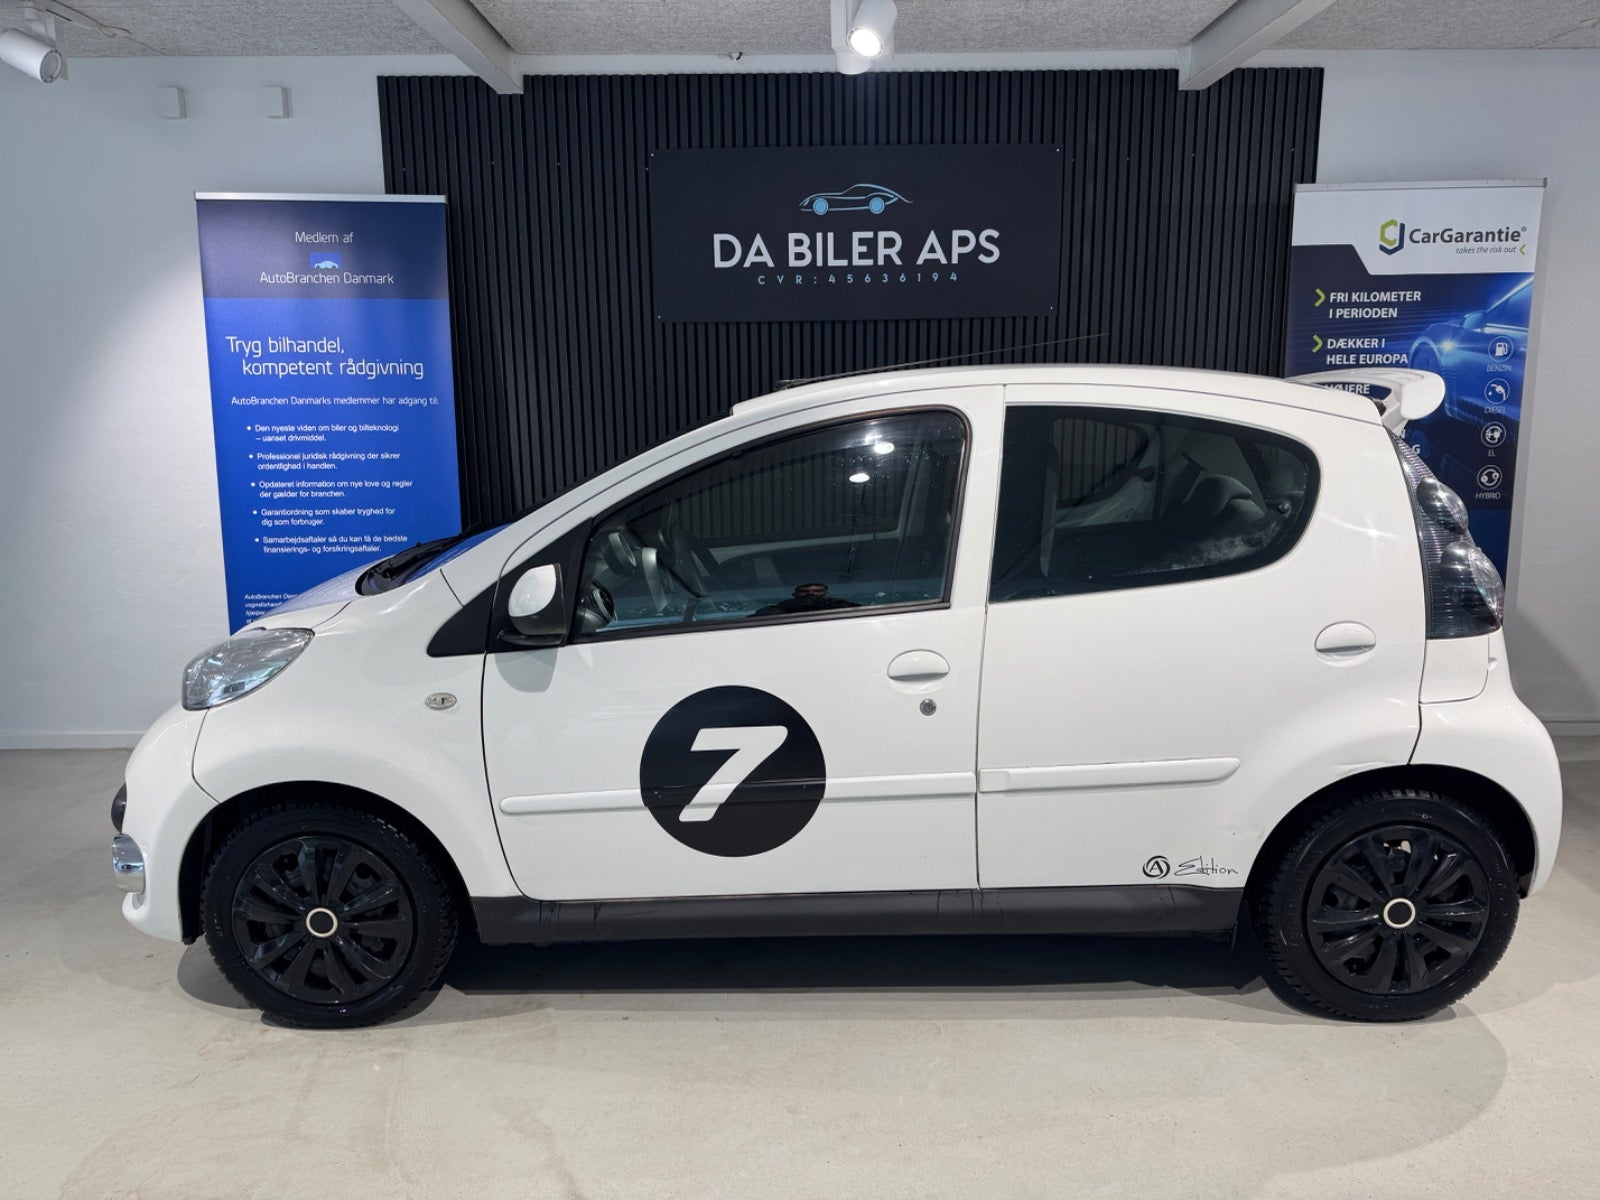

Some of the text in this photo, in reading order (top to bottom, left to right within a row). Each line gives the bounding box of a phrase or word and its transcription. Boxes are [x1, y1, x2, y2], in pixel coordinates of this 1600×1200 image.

[295, 232, 354, 243] Medlem af
[713, 229, 1000, 268] DA BILER APS
[1476, 246, 1489, 254] the
[260, 272, 394, 284] AutoBranchen Danmark
[1330, 291, 1421, 303] FRI KILOMETER
[1336, 308, 1398, 319] PERIODEN
[225, 336, 345, 358] Tryg bilhandel,
[1328, 338, 1379, 349] DÆKKER
[1327, 353, 1408, 365] HELE EUROPA
[242, 359, 424, 380] kompetent rådgivning
[1487, 364, 1511, 372] BENZIN
[232, 396, 288, 405] AutoBranchen
[291, 396, 331, 405] Danmarks
[334, 396, 380, 405] medlemmer
[383, 396, 395, 405] har
[399, 396, 427, 407] adgang
[255, 424, 270, 432] Den
[272, 425, 295, 433] nyeste
[297, 424, 316, 432] viden
[332, 424, 346, 432] biler
[348, 425, 357, 433] og
[359, 424, 399, 433] bilteknologi
[288, 434, 327, 442] drivmiddel.
[302, 452, 328, 461] juridisk
[329, 452, 366, 461] rådgivning
[1488, 449, 1496, 457] EL
[258, 462, 301, 471] ordentlighed
[307, 462, 338, 470] handlen.
[259, 480, 294, 490] Opdateret
[296, 480, 335, 488] information
[350, 481, 363, 489] nye
[381, 481, 390, 489] og
[392, 480, 412, 488] regler
[273, 491, 298, 500] gælder
[1476, 491, 1501, 500] HYBRID
[261, 508, 313, 517] Garantiordning
[357, 508, 384, 516] tryghed
[385, 507, 396, 515] for
[262, 519, 273, 527] dig
[263, 536, 326, 544] Samarbejdsaftaler
[679, 725, 788, 822] 7
[1174, 855, 1238, 876] Edition
